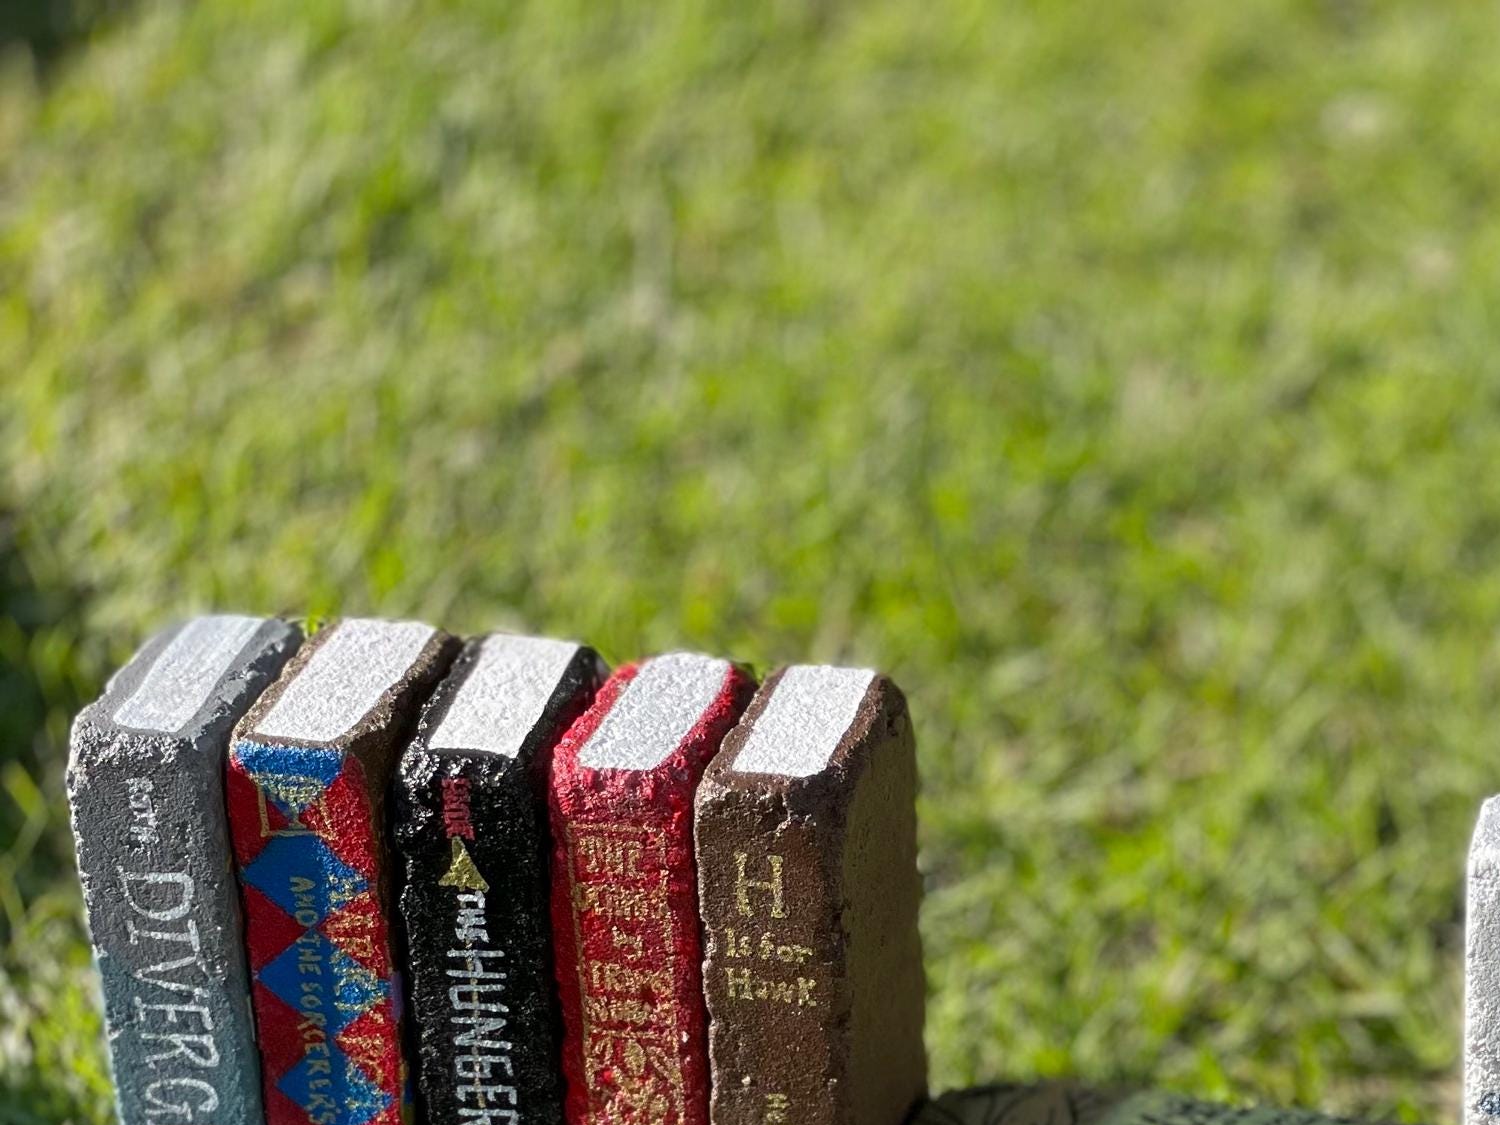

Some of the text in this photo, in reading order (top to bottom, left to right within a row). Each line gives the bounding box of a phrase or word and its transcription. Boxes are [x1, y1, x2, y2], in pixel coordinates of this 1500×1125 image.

[732, 851, 790, 919] H
[454, 890, 490, 944] THE
[296, 933, 324, 974] THE
[297, 982, 342, 1125] SORCERER'S
